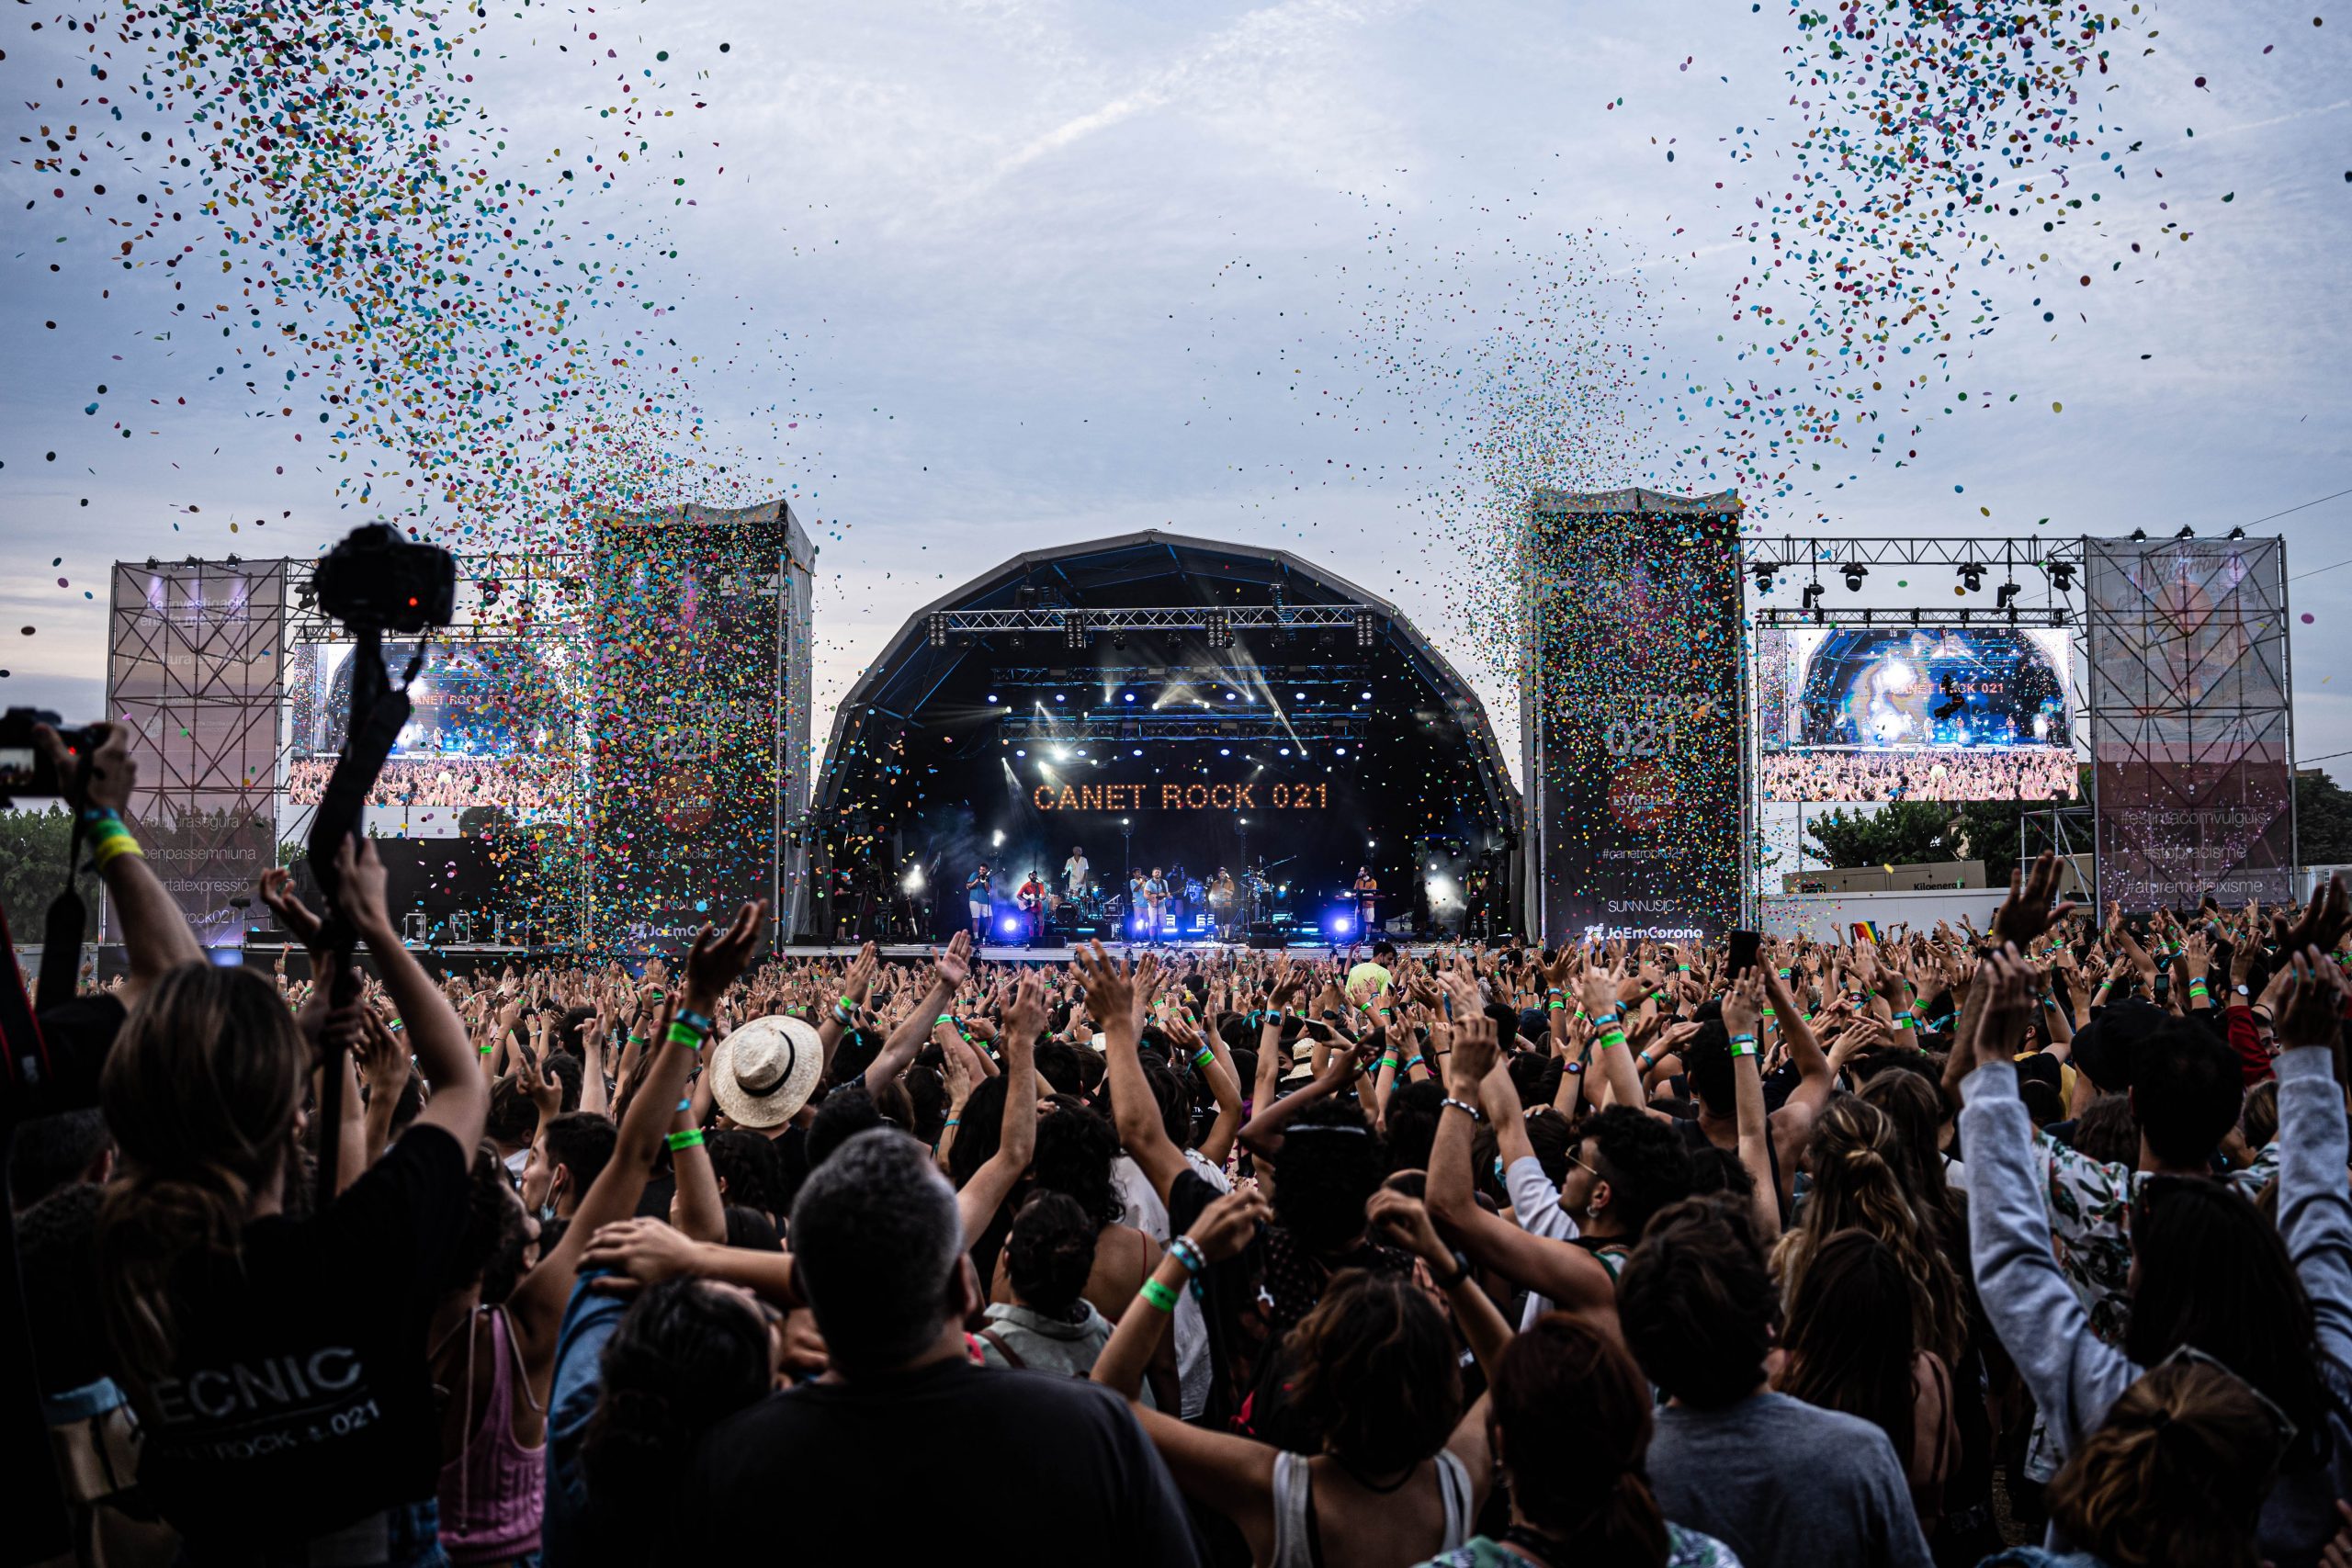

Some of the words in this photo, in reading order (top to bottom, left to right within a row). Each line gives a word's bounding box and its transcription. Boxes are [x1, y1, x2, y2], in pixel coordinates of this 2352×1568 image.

[1981, 682, 2004, 694] 021
[409, 695, 445, 705] ANET
[1607, 719, 1677, 757] 021
[1033, 784, 1147, 809] CANET
[1162, 783, 1257, 809] ROCK
[1272, 783, 1328, 809] 021
[141, 816, 239, 831] #culturasegura
[2120, 811, 2267, 829] #estimacomvulguis
[143, 848, 256, 862] oenpassemniuna
[2143, 844, 2247, 862] #stopracisme
[1914, 882, 1965, 891] Kiloenerga
[185, 909, 235, 925] rock021
[148, 1345, 362, 1427] ECNIC
[329, 1397, 381, 1437] 021
